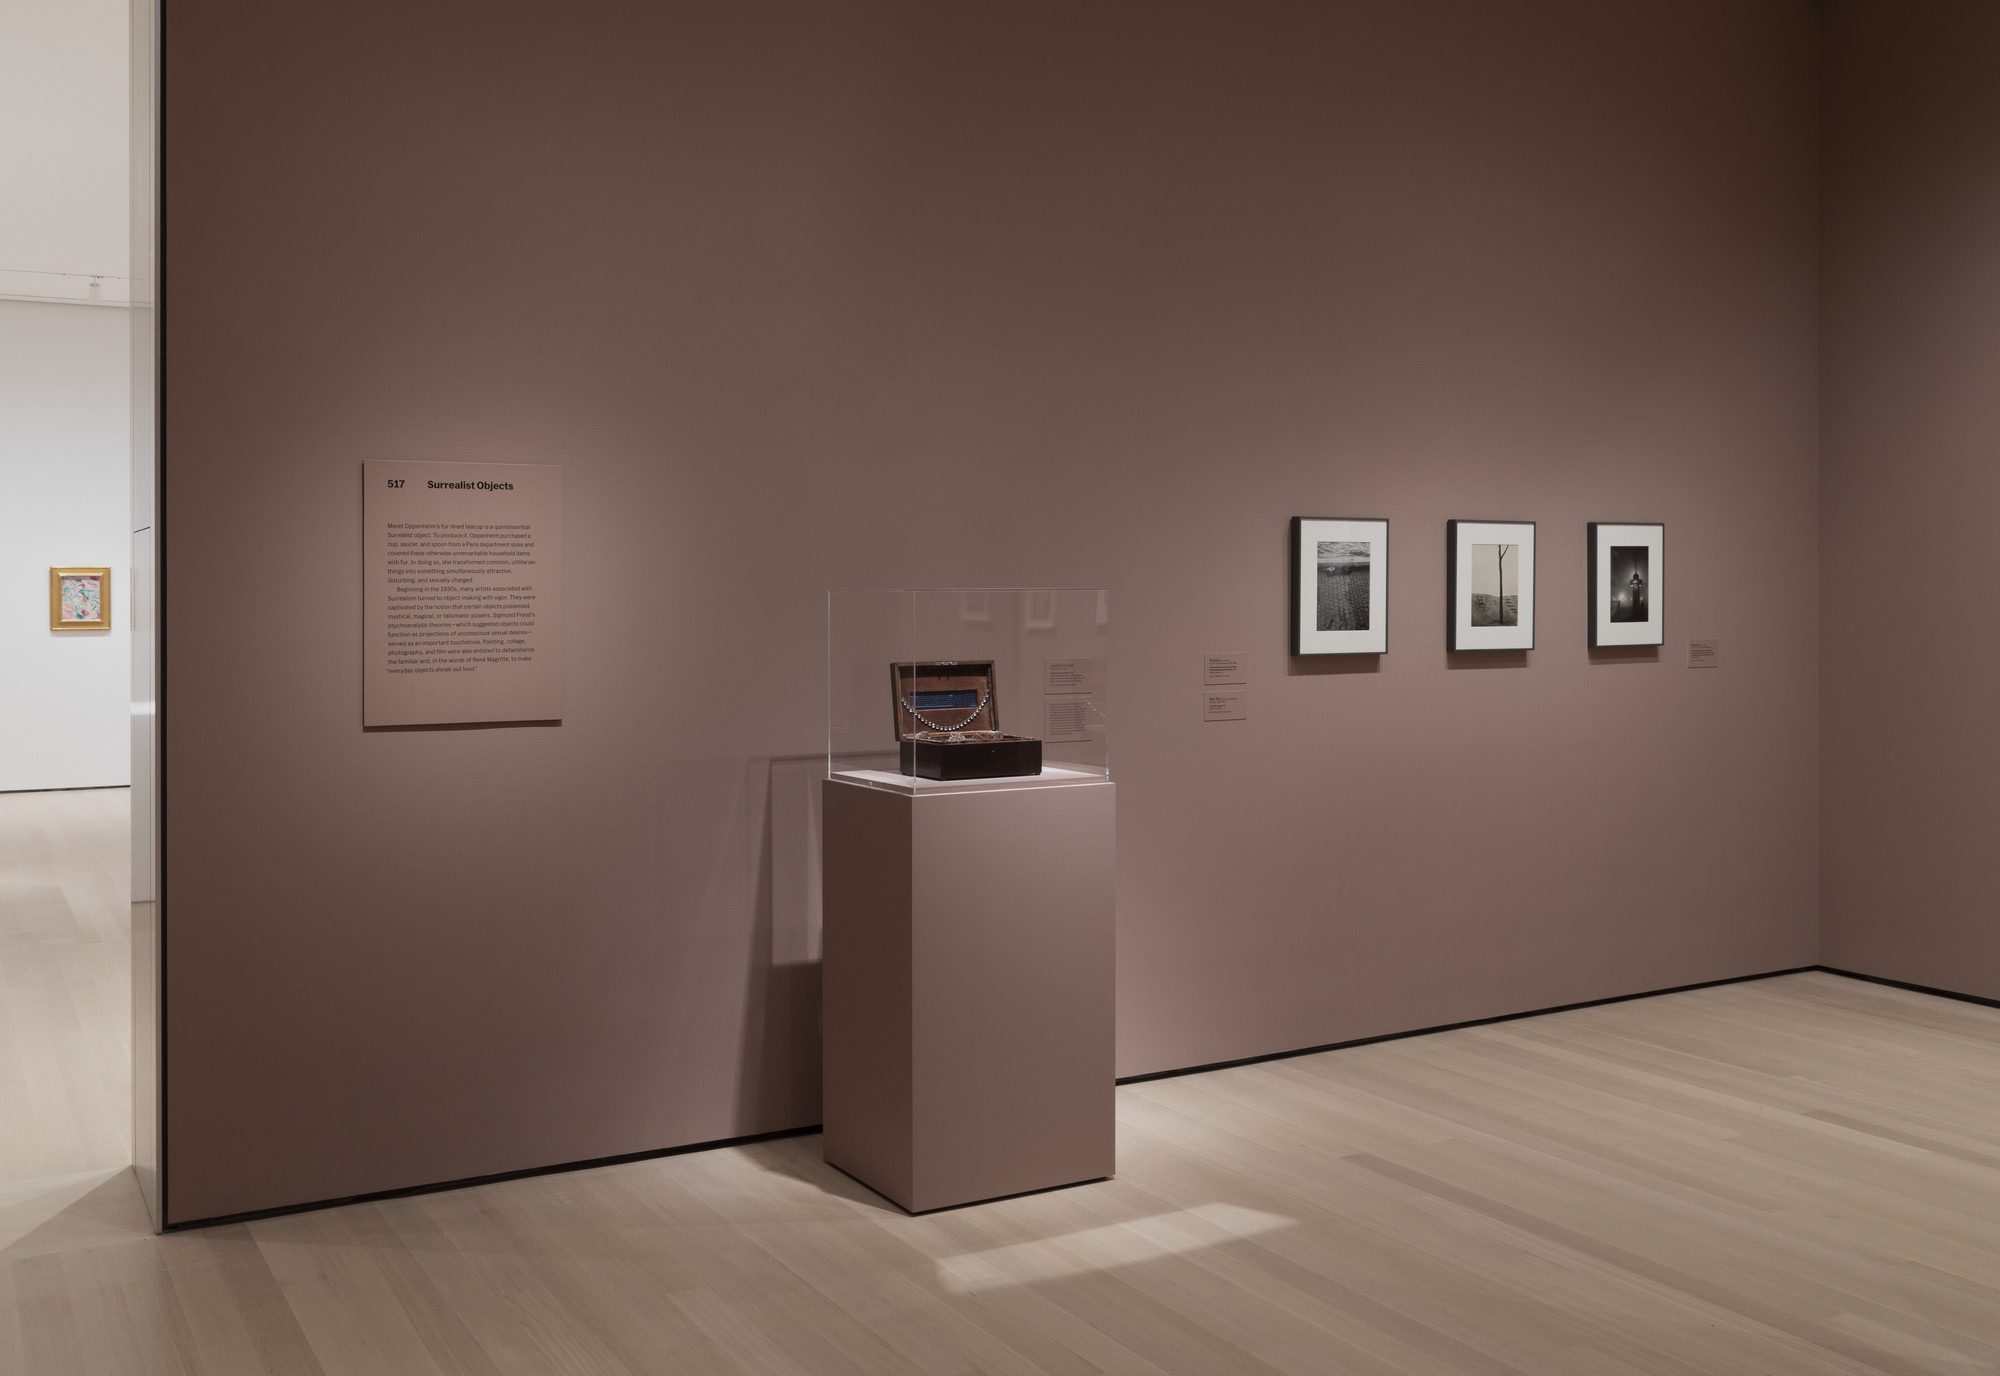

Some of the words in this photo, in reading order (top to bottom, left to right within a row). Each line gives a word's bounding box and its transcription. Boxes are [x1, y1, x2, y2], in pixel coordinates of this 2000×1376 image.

[387, 480, 405, 488] 517
[427, 480, 475, 490] Surrealist
[476, 481, 514, 491] Objects
[494, 523, 530, 531] quintessential
[387, 621, 428, 629] psychoanalytic
[472, 620, 499, 628] suggested
[419, 630, 449, 638] projections
[423, 639, 449, 647] important
